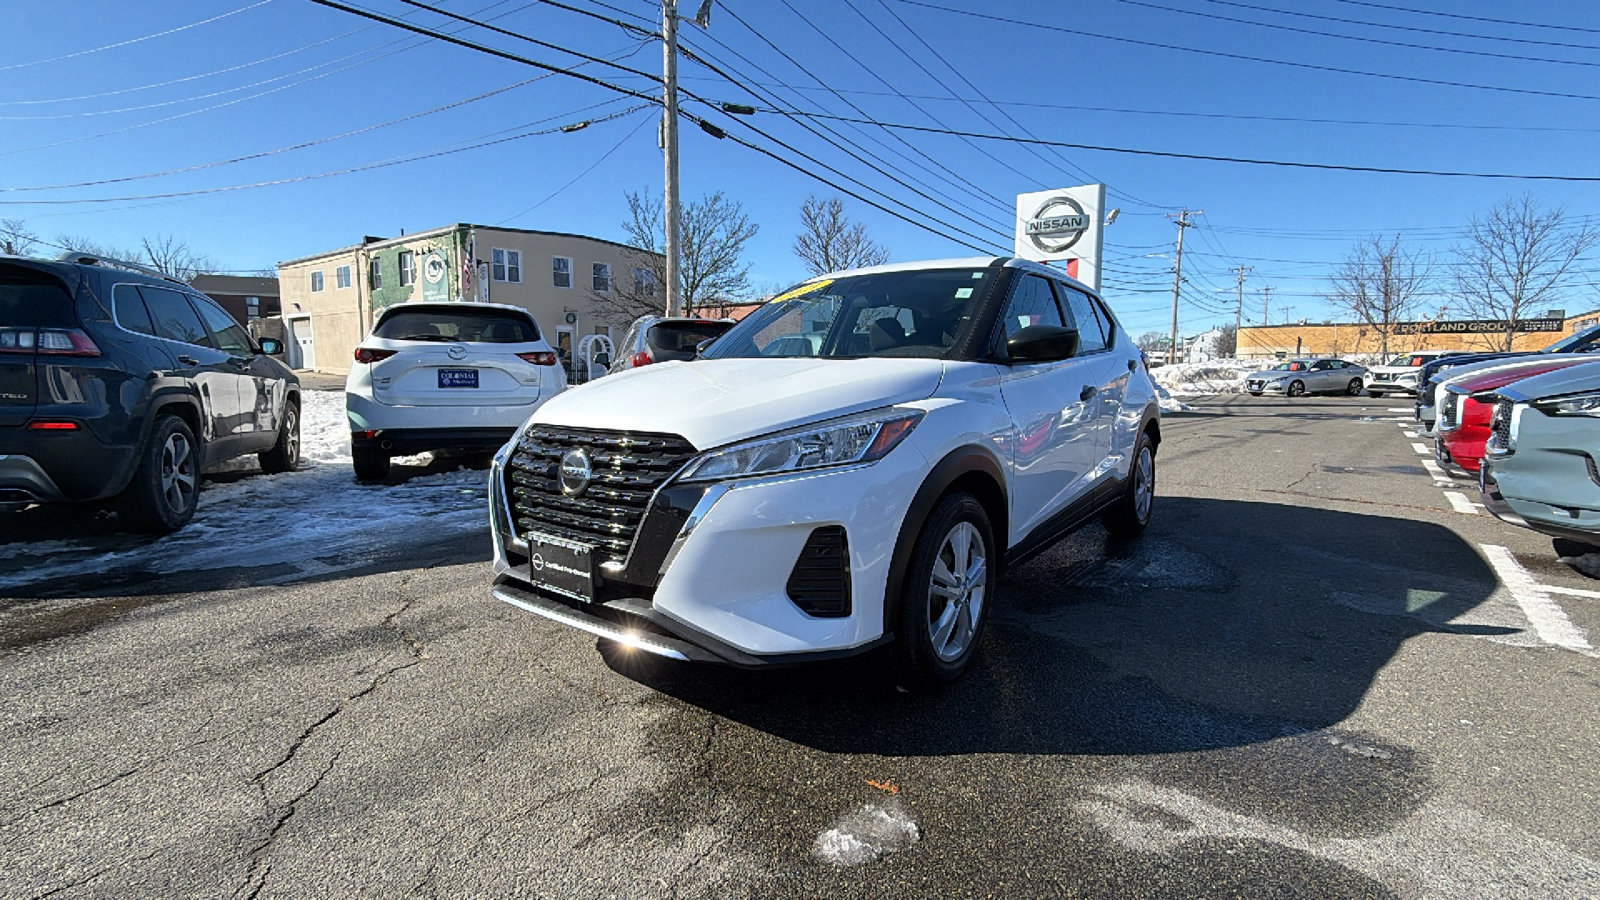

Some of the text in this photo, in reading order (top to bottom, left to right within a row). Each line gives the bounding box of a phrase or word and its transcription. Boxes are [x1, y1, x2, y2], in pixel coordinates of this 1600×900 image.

[1030, 218, 1082, 230] NISSAN
[1468, 321, 1515, 332] GROU
[545, 561, 591, 579] Certified Pre-Owned
